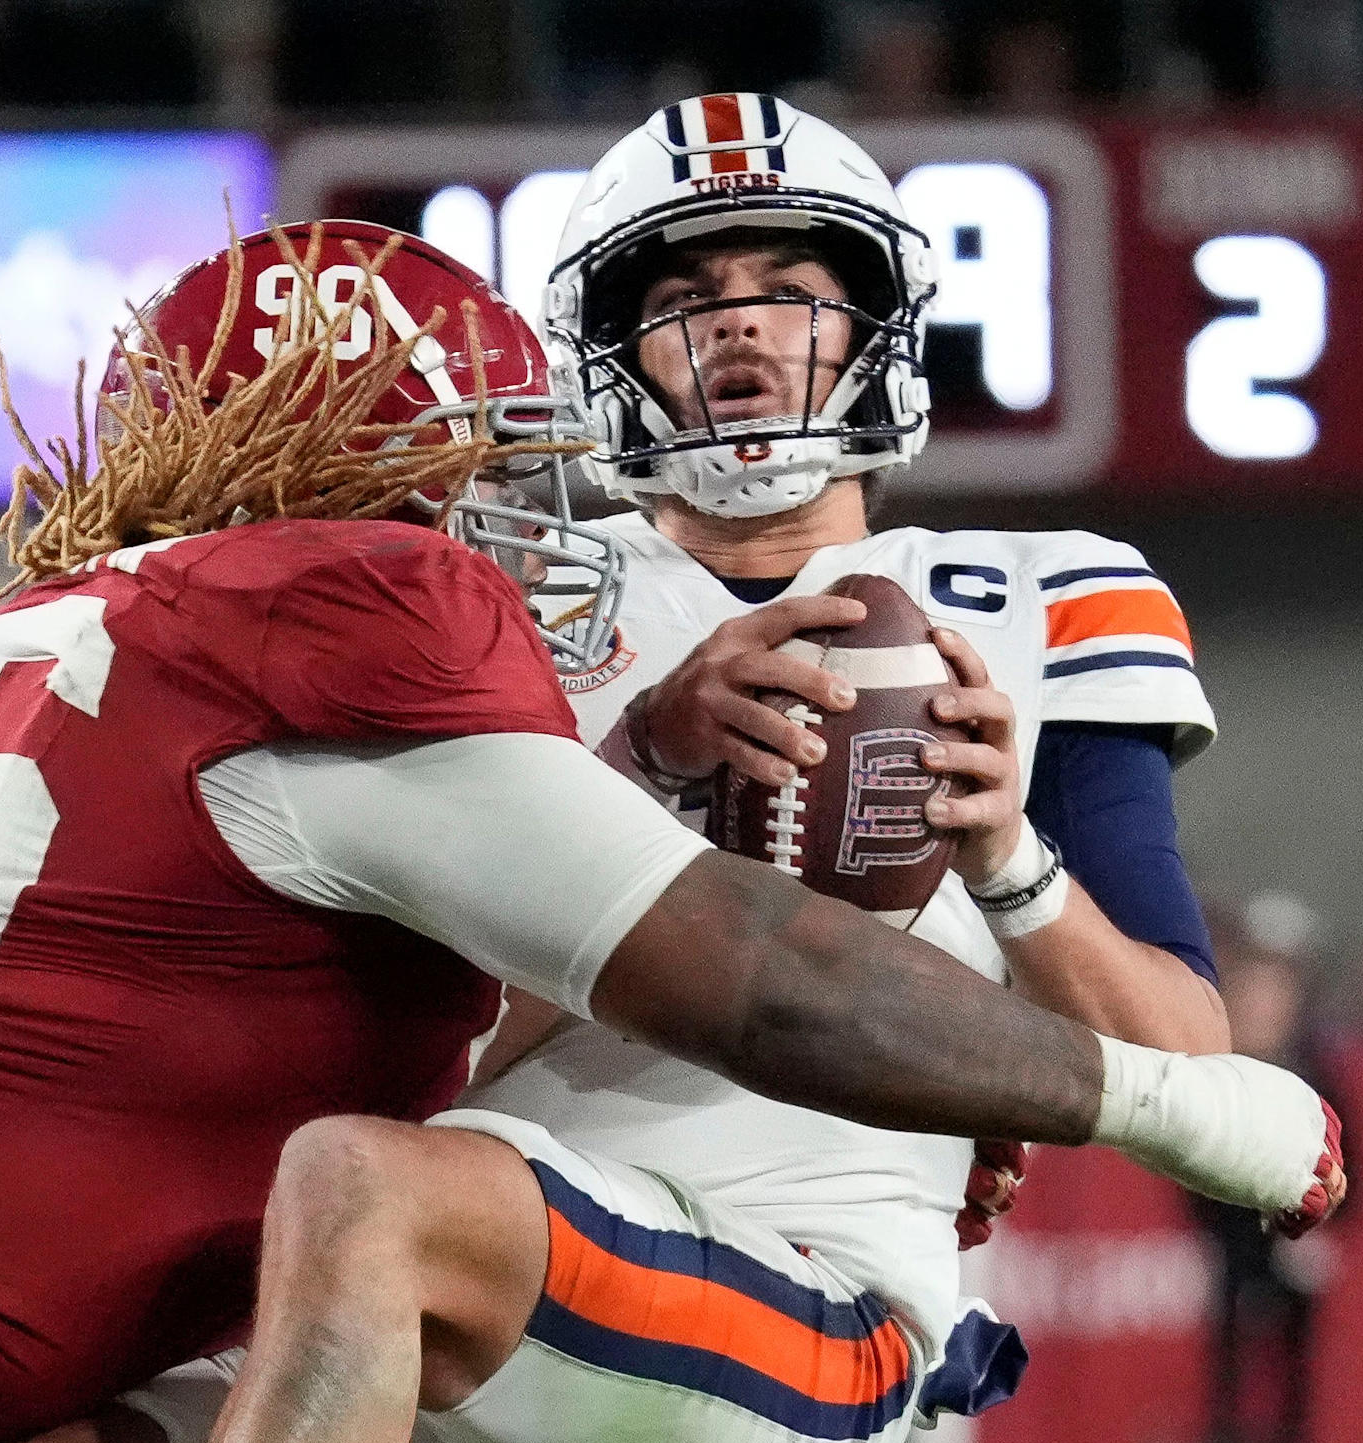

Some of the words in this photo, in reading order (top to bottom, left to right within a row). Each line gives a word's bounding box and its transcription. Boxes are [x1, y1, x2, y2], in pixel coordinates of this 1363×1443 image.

[690, 173, 780, 195] TIGERS
[1184, 234, 1326, 459] 2
[929, 563, 1007, 613] C
